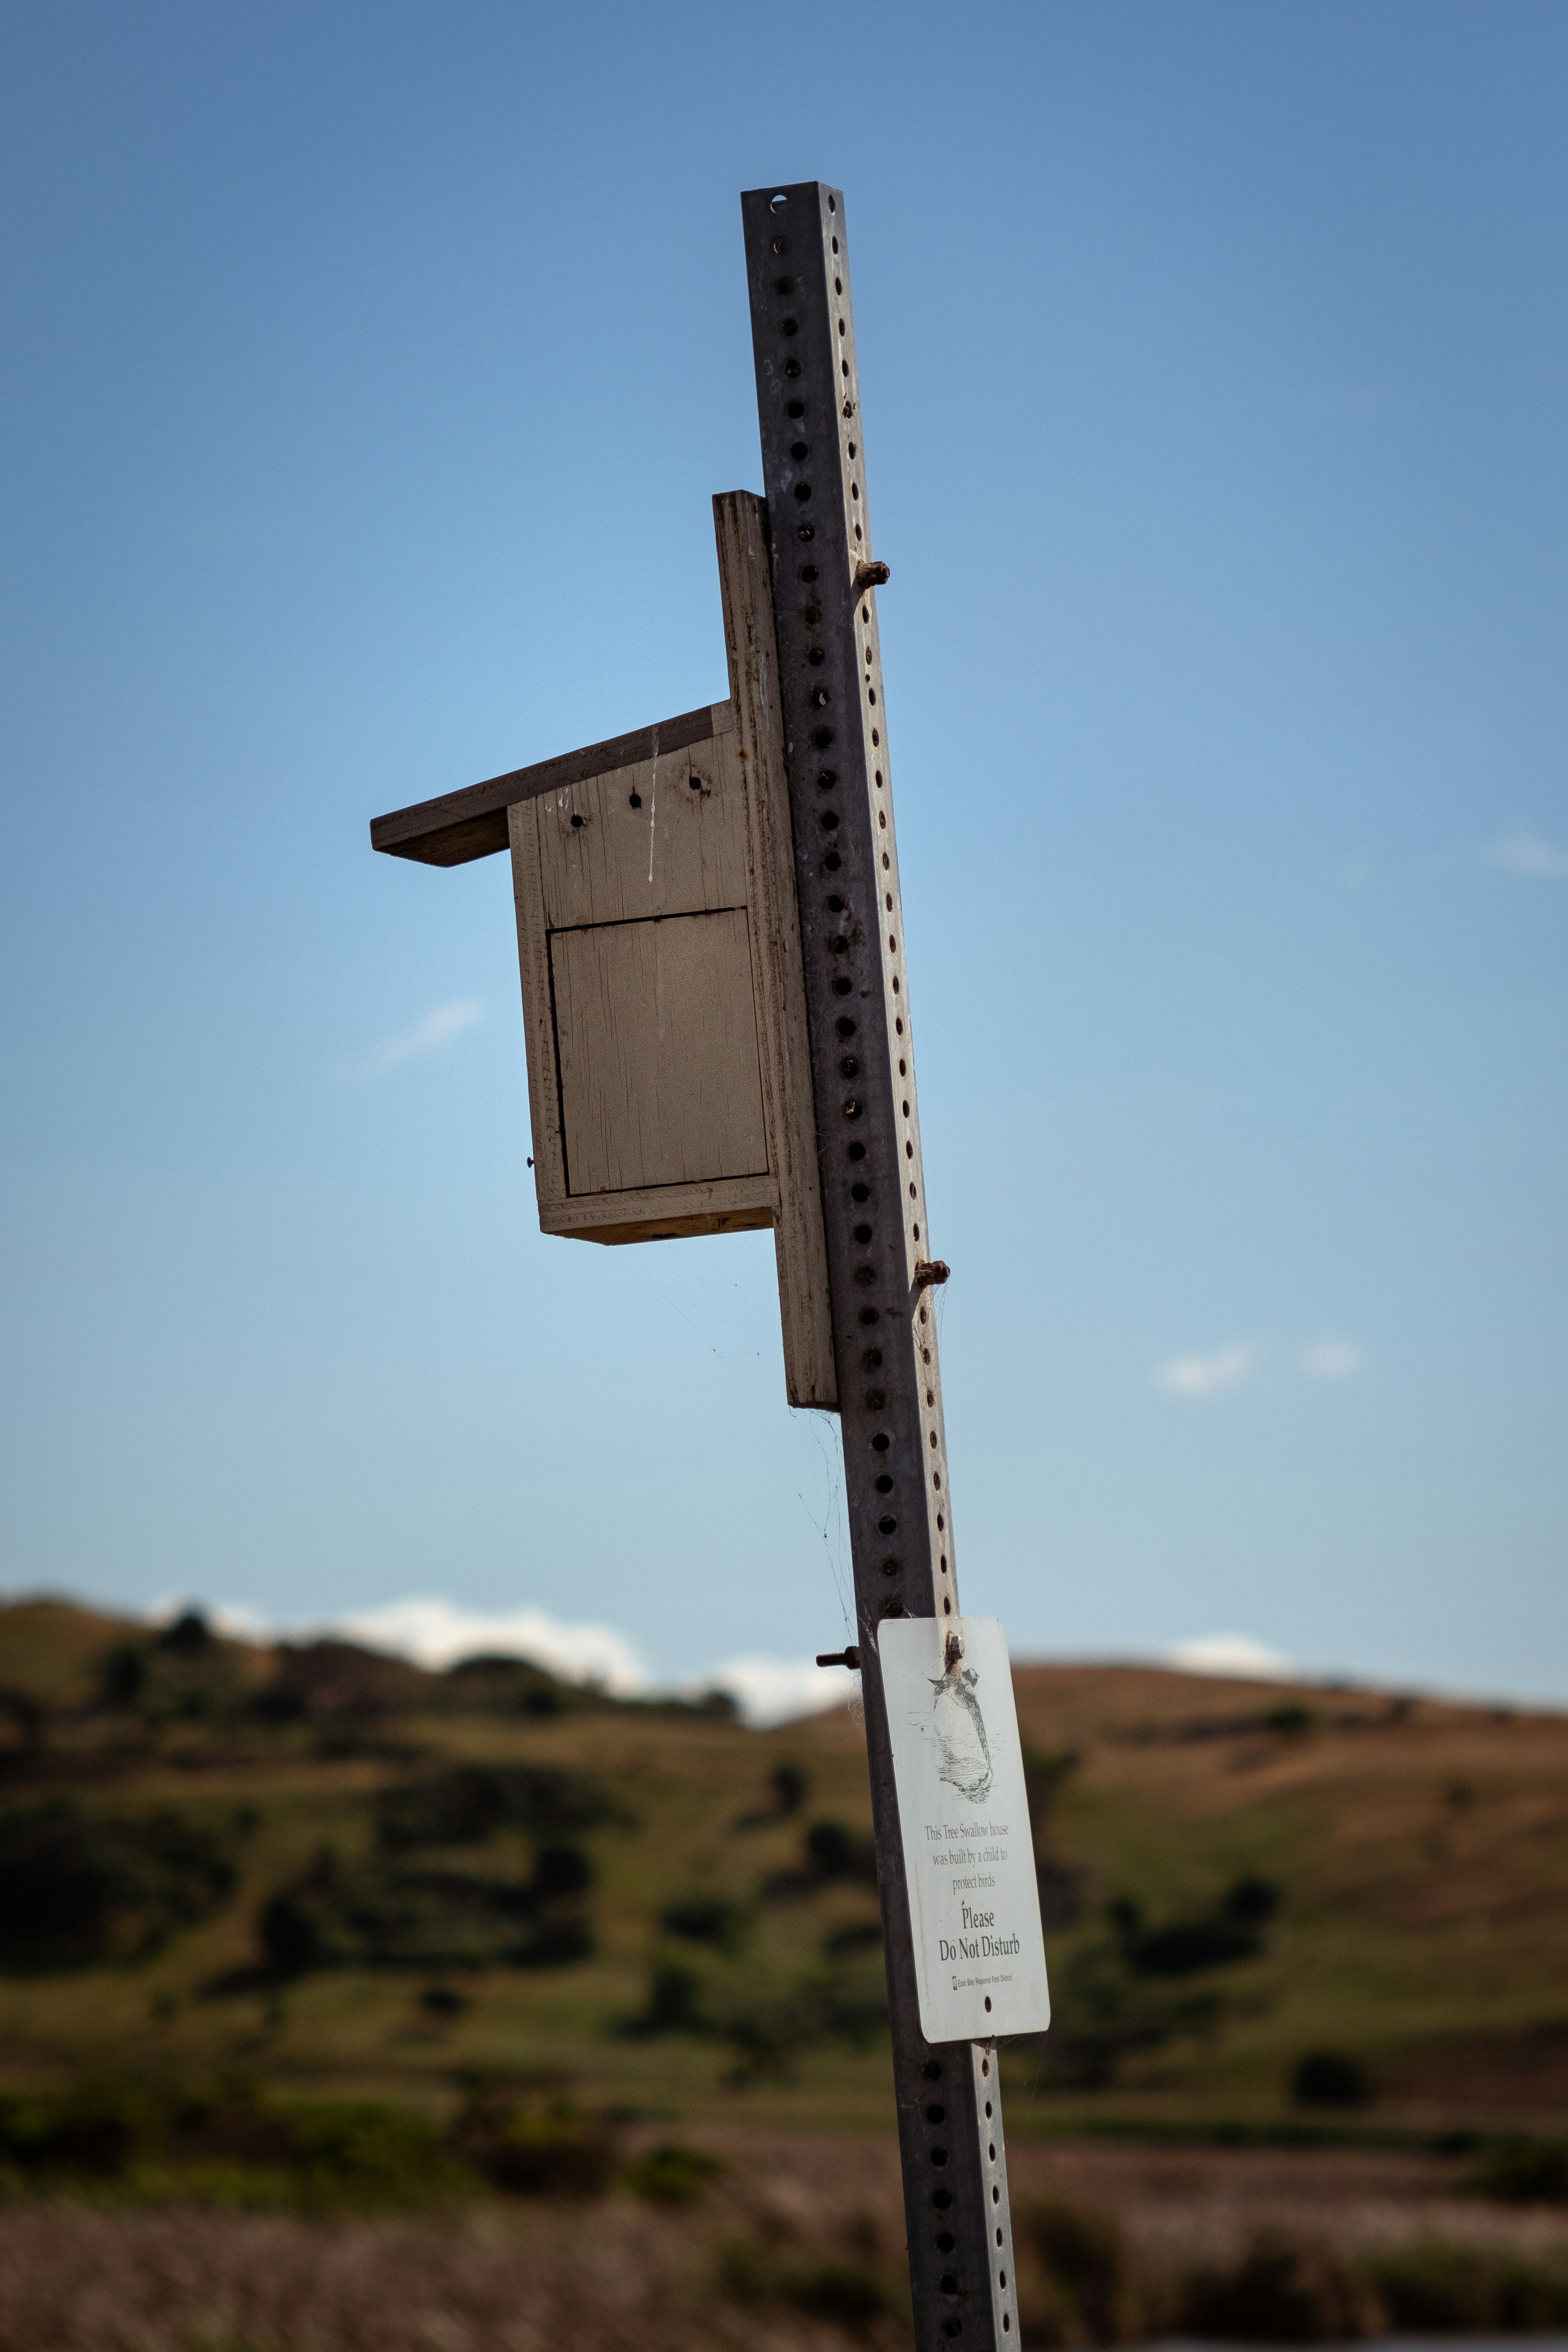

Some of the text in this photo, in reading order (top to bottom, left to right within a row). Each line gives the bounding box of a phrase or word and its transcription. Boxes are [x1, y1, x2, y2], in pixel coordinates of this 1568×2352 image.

[924, 1822, 1009, 1840] This Tree Swallow house
[933, 1855, 948, 1866] was
[949, 1849, 966, 1864] built
[967, 1848, 976, 1868] by
[983, 1846, 999, 1862] child
[1001, 1848, 1007, 1861] to
[952, 1873, 995, 1895] protect birds
[962, 1907, 994, 1929] Please
[939, 1933, 1020, 1961] Do Not Disturb
[976, 1977, 991, 1986] Regional
